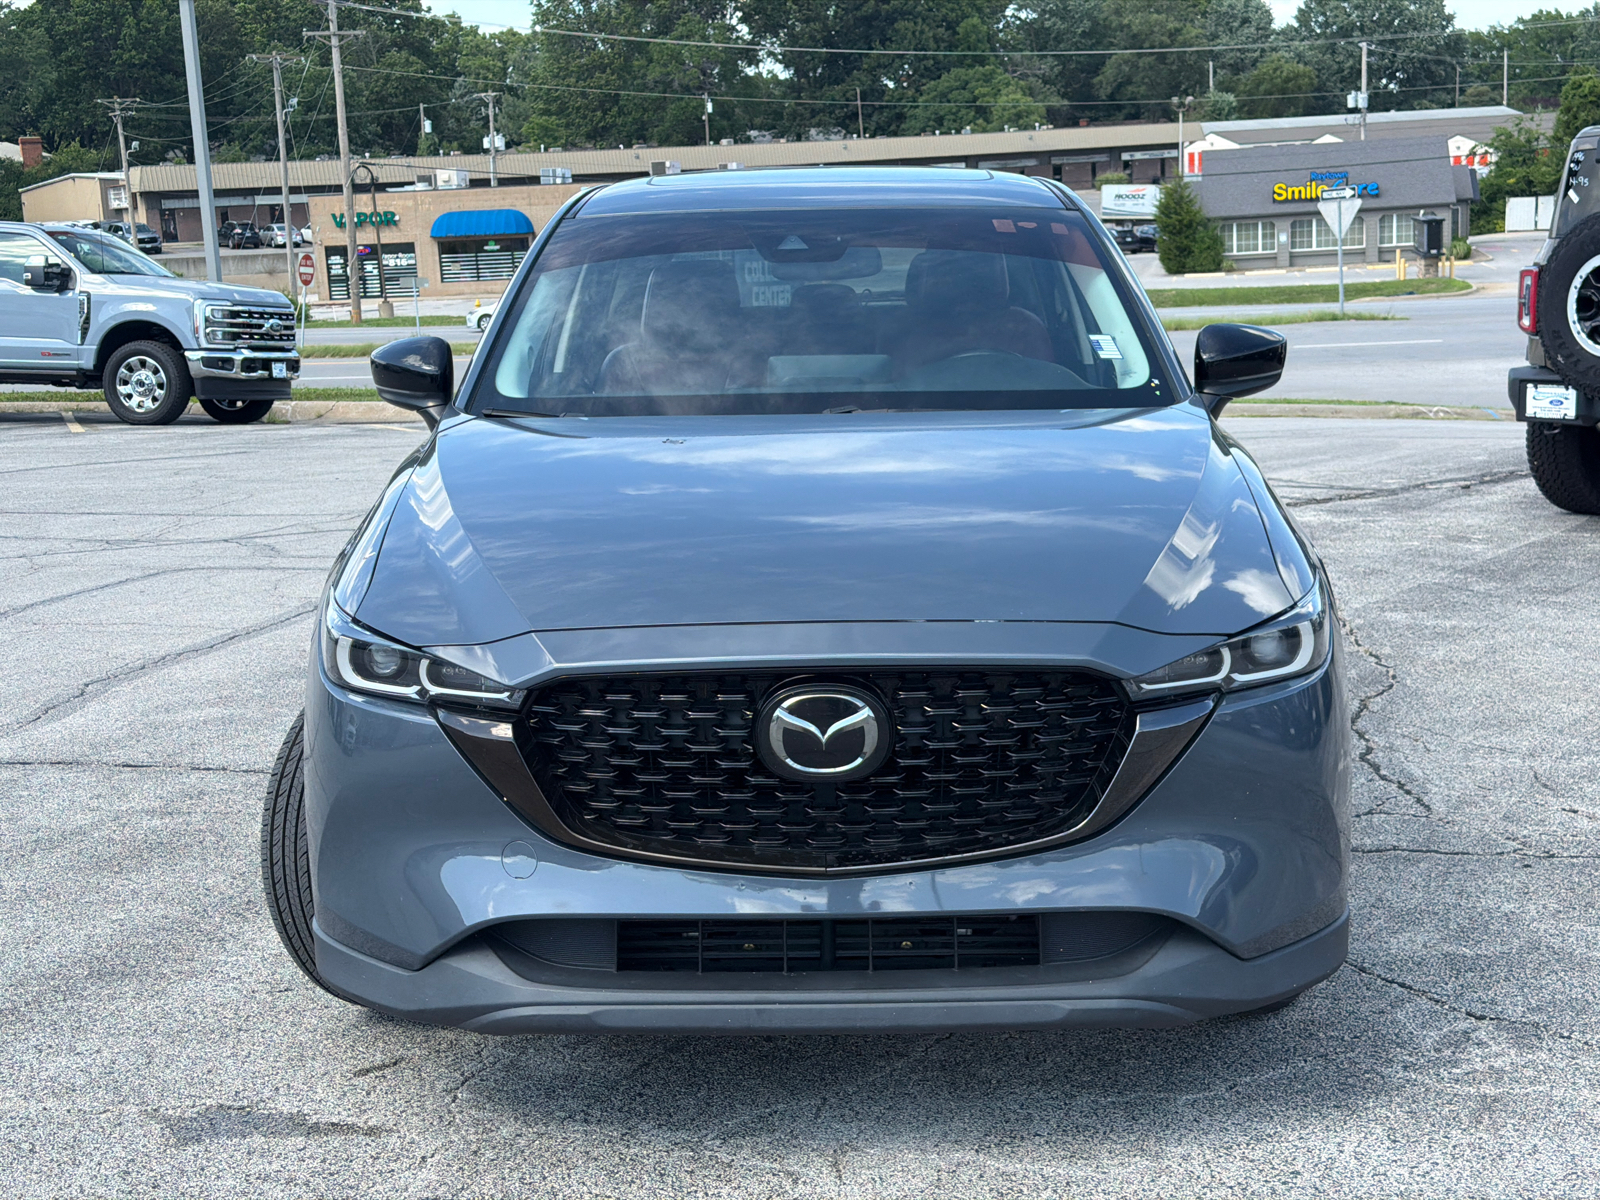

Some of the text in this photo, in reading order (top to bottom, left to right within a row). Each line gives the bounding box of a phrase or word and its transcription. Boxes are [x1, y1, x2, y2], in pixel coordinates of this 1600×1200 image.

[1310, 171, 1349, 181] Raytown
[331, 211, 397, 229] VPOR
[388, 259, 408, 267] 816
[752, 285, 792, 307] CENTER
